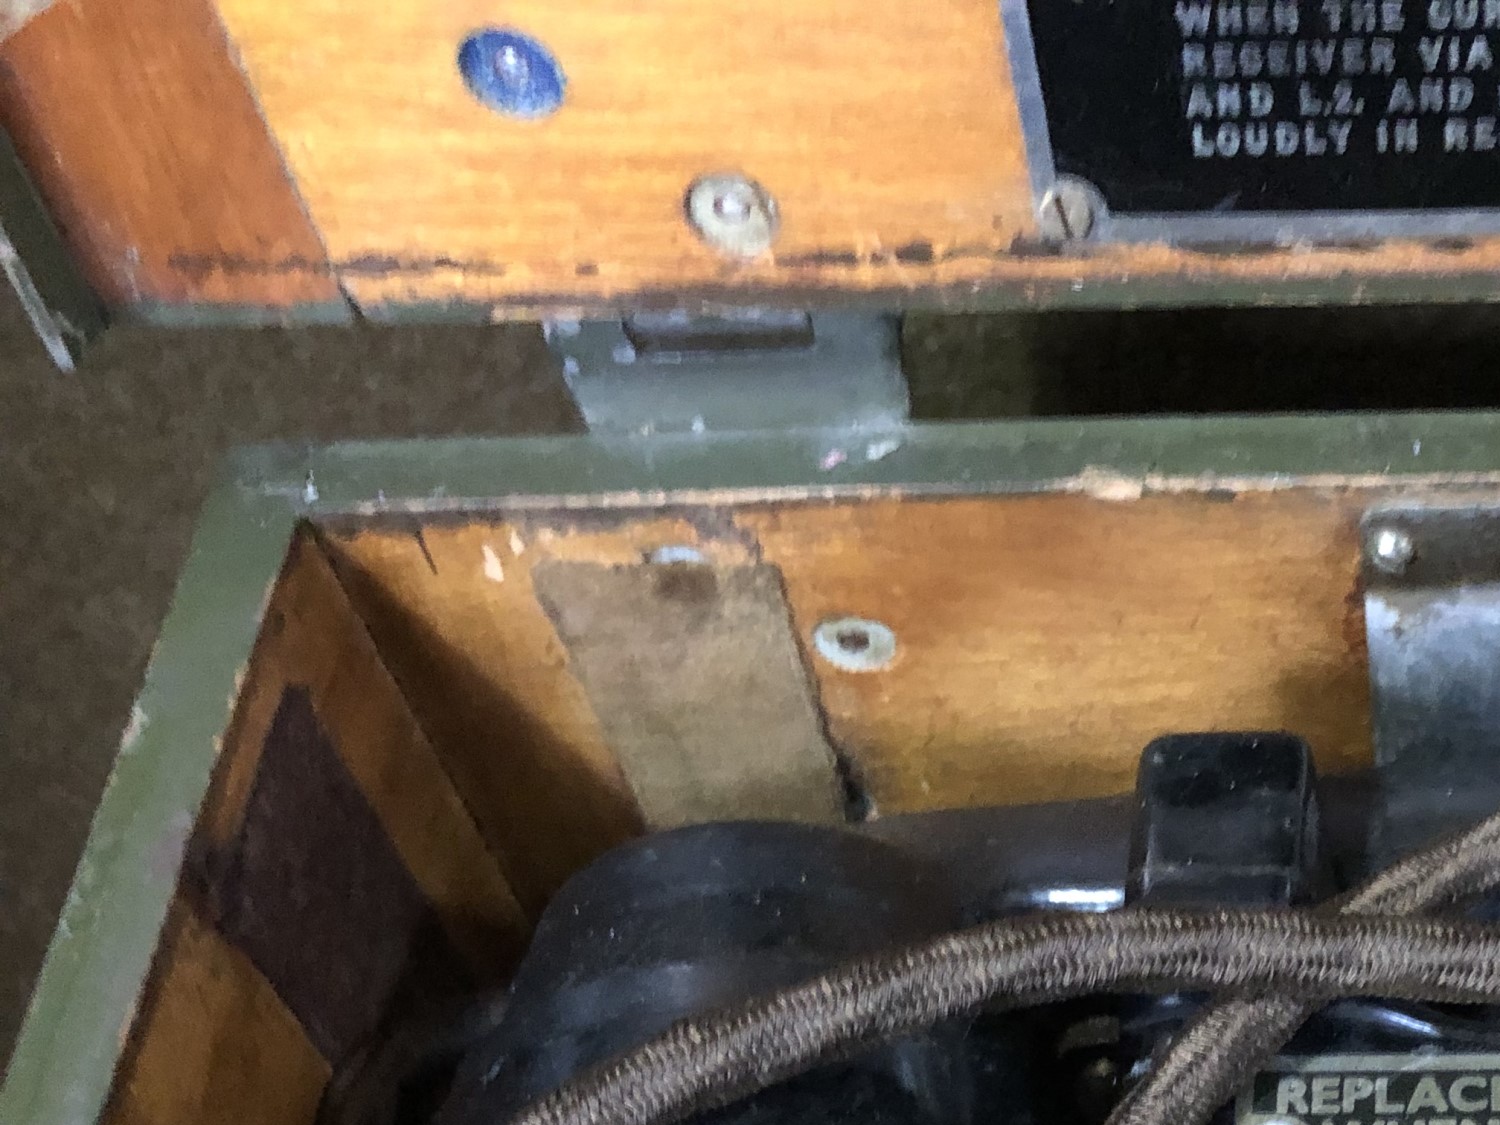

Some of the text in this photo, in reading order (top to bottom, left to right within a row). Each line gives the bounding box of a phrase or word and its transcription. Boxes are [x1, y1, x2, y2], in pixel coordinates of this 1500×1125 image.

[1174, 0, 1299, 37] WHEN
[1321, 0, 1405, 33] THE
[1182, 37, 1396, 77] RECEIVER
[1418, 34, 1493, 73] VIA
[1186, 81, 1274, 119] AND
[1387, 77, 1475, 114] AND
[1192, 120, 1352, 158] LOUDLY
[1376, 117, 1418, 154] IN
